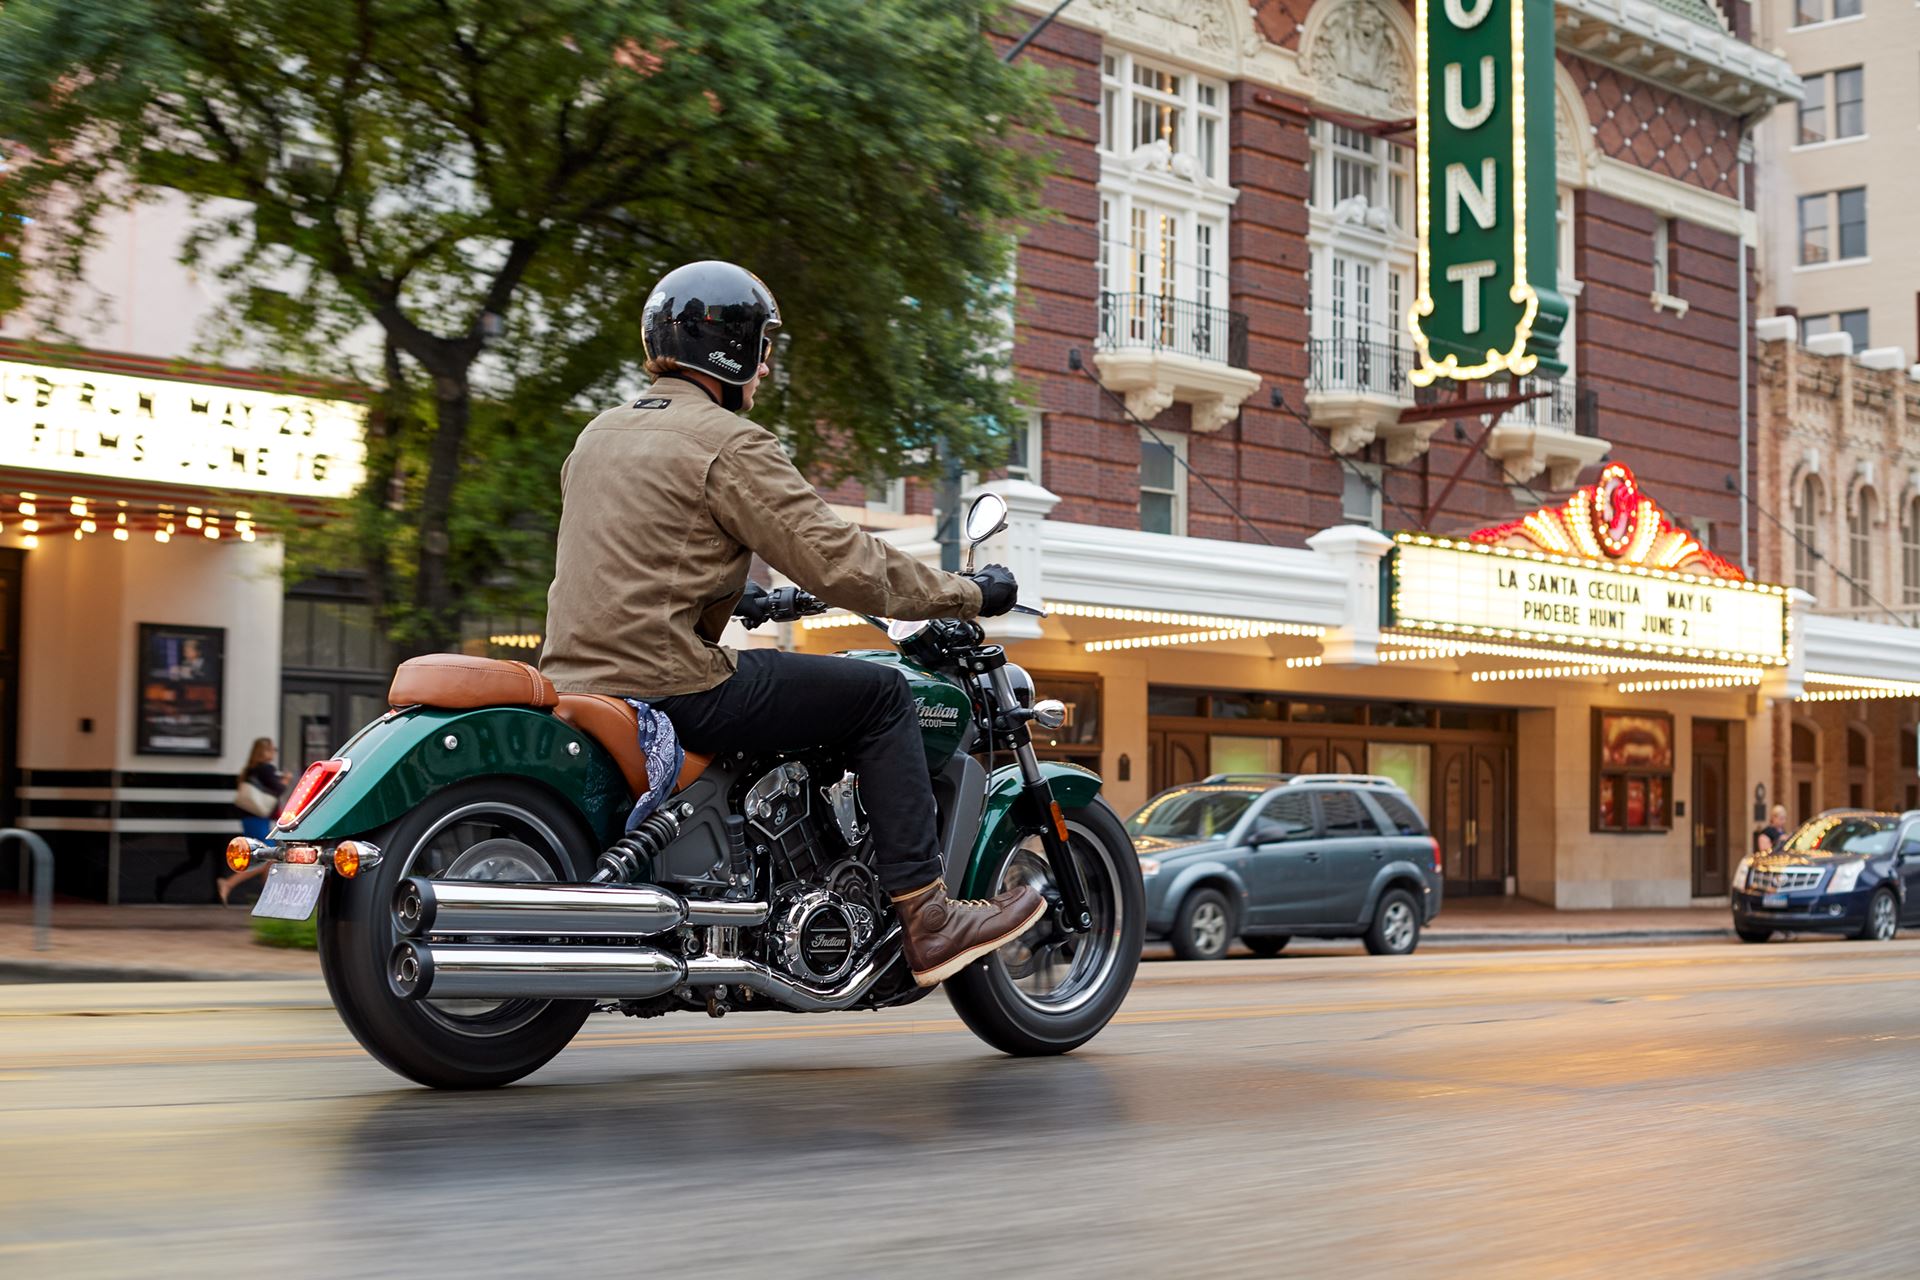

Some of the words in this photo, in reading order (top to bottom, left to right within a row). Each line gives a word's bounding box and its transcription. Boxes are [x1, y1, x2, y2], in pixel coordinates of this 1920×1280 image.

[708, 350, 742, 371] Indian
[188, 397, 256, 430] MAY
[271, 405, 316, 437] 23
[31, 422, 145, 463] FILMS
[1498, 568, 1519, 589] LA
[1527, 572, 1579, 597] SANTA
[1588, 581, 1641, 604] CECILIA
[1667, 591, 1694, 611] MAY
[1700, 595, 1713, 613] 16
[1523, 600, 1581, 626] PHOEBE
[1588, 608, 1626, 630] HUNT
[1641, 615, 1675, 636] JUNE
[1681, 619, 1689, 637] 2
[913, 696, 960, 719] Indian
[920, 718, 943, 728] SCOUT
[811, 933, 847, 948] Indian
